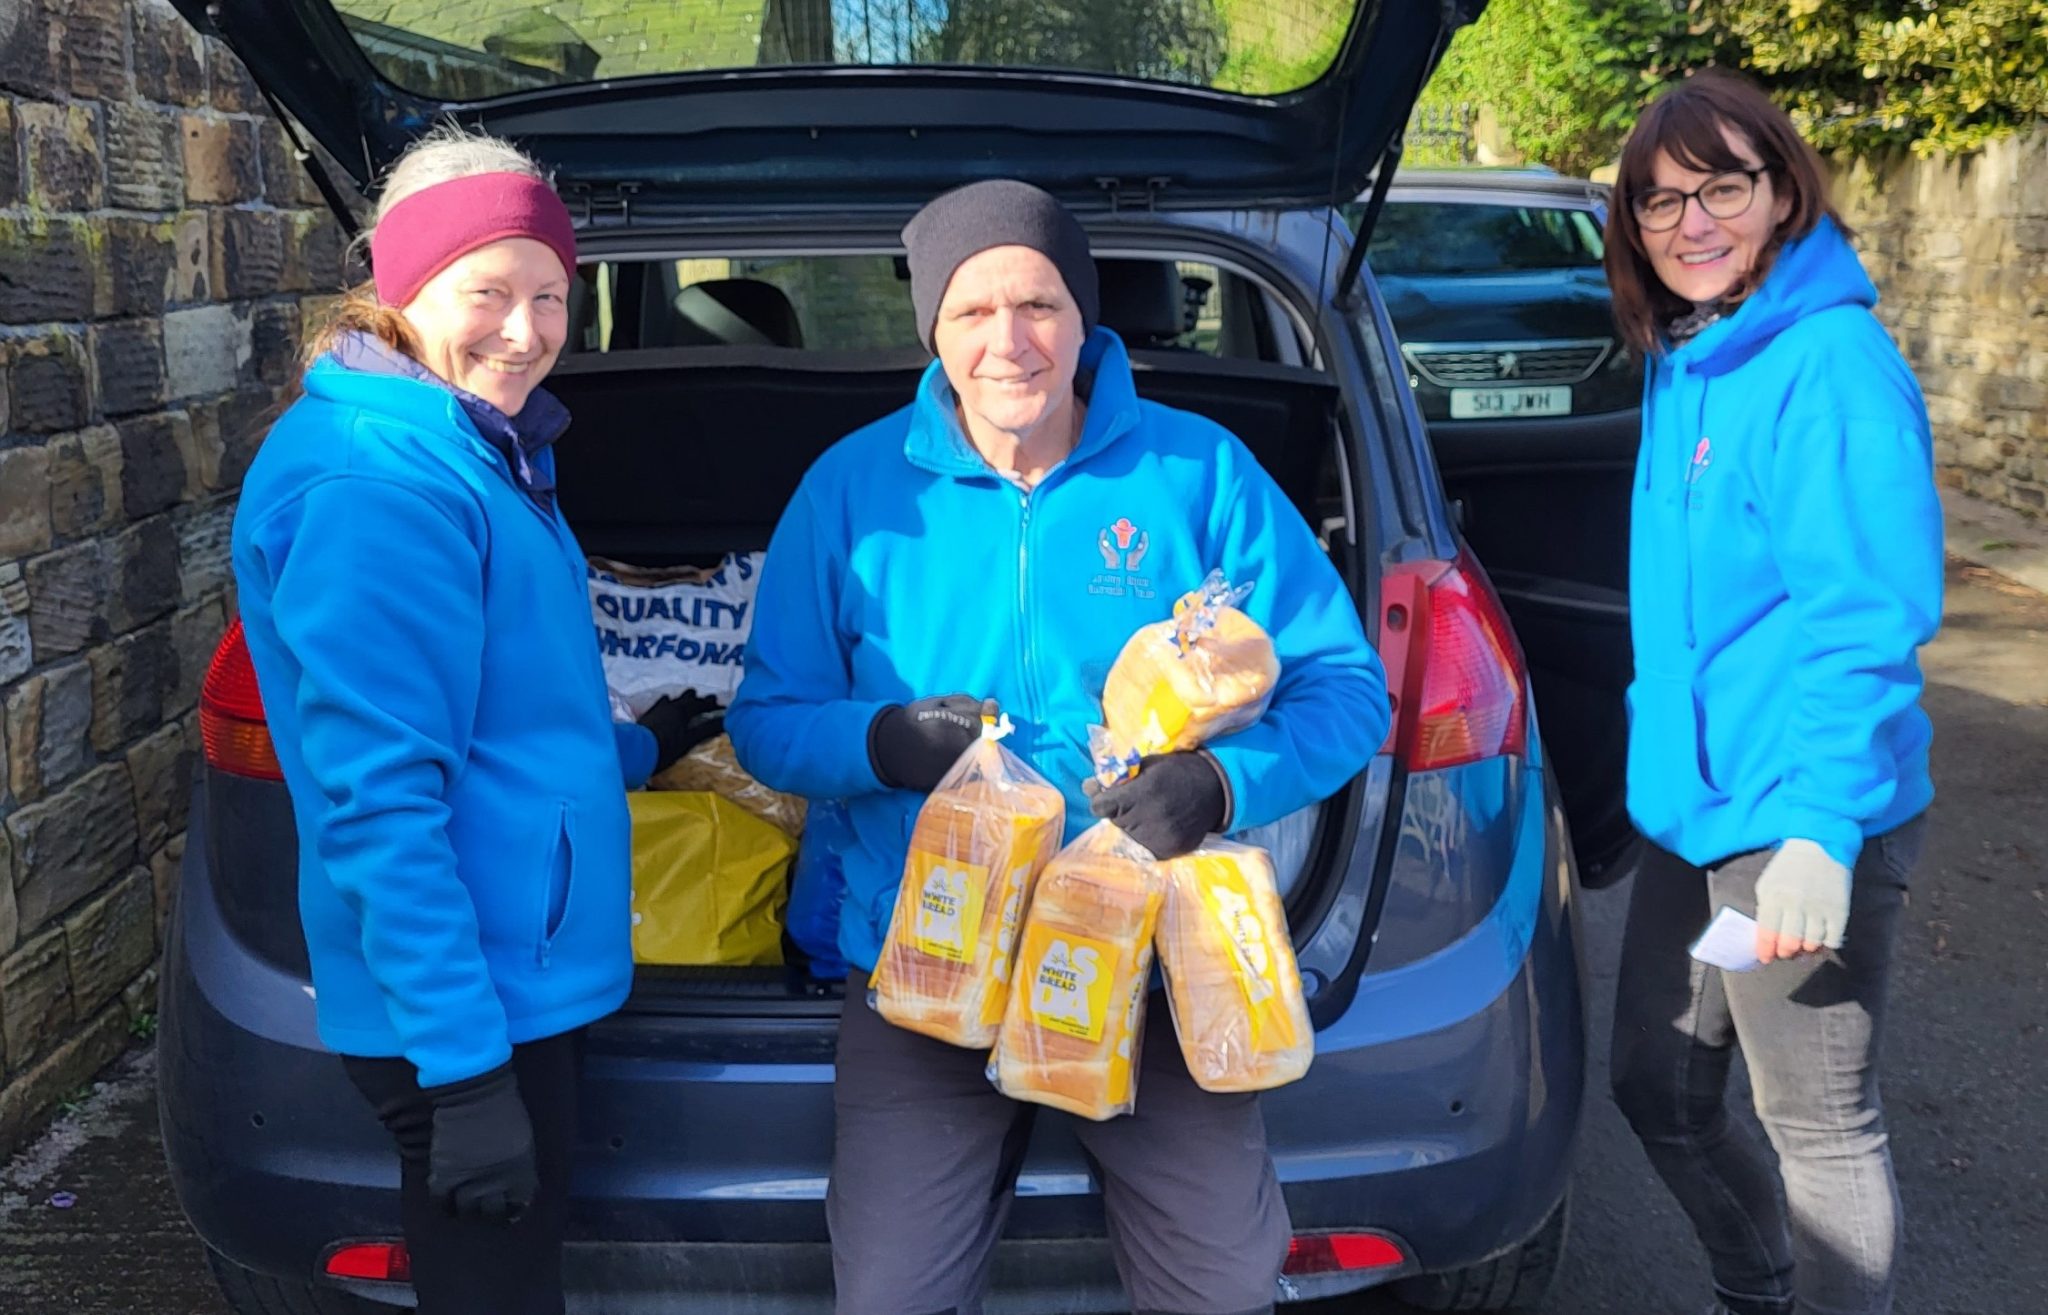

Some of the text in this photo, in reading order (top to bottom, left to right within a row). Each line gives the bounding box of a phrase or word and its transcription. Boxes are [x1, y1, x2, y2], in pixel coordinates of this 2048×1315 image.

[596, 593, 748, 629] QUALITY
[1042, 964, 1078, 982] WHITE
[1039, 974, 1077, 992] BREAD
